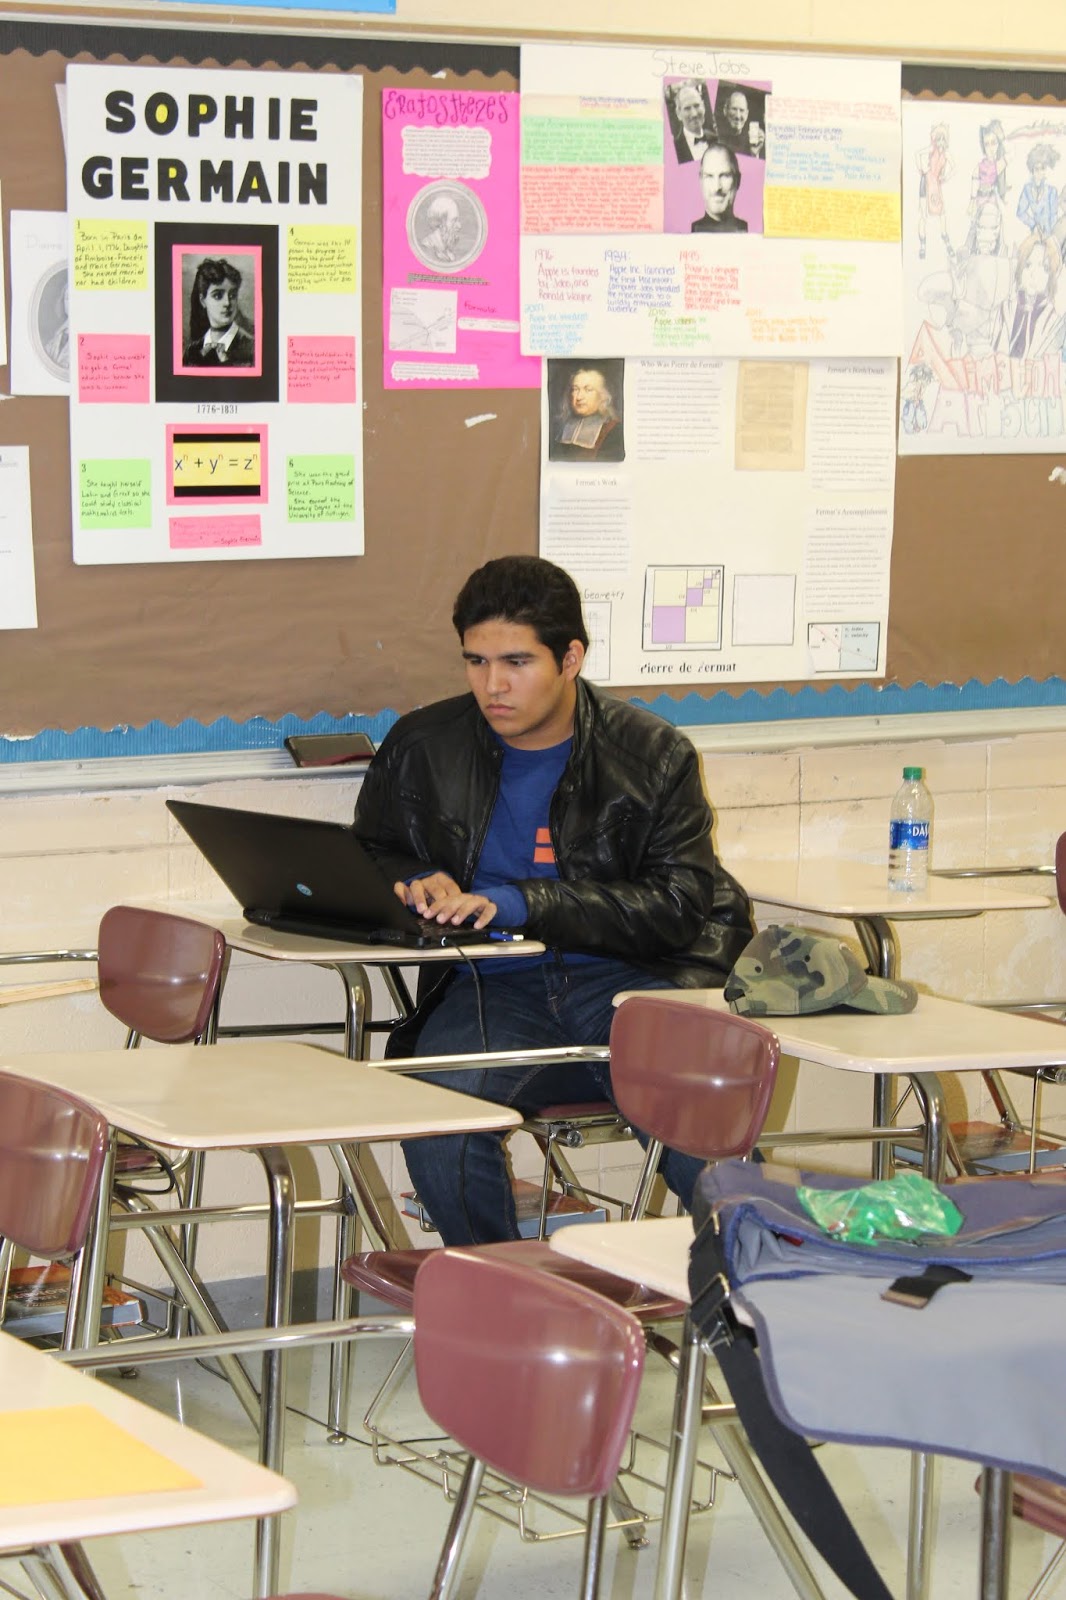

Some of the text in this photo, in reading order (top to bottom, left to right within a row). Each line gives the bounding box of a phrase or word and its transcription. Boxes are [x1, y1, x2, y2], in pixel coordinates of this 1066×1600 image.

[651, 50, 751, 77] Steve Jobs
[105, 90, 318, 141] SOPHIE
[82, 156, 328, 205] GERMAIN
[77, 220, 80, 230] 1
[538, 263, 559, 280] Apple
[571, 265, 599, 277] founded
[538, 290, 564, 301] Ronald
[80, 337, 85, 346] 2
[289, 338, 294, 348] 5
[640, 360, 655, 368] Who
[657, 360, 670, 368] Was
[671, 360, 689, 368] Pierre
[690, 360, 698, 368] de
[197, 404, 239, 415] 1776-1831
[81, 463, 87, 472] 3
[289, 458, 294, 468] 6
[601, 478, 617, 487] Work
[815, 508, 840, 516] Fermat's
[679, 662, 692, 673] de
